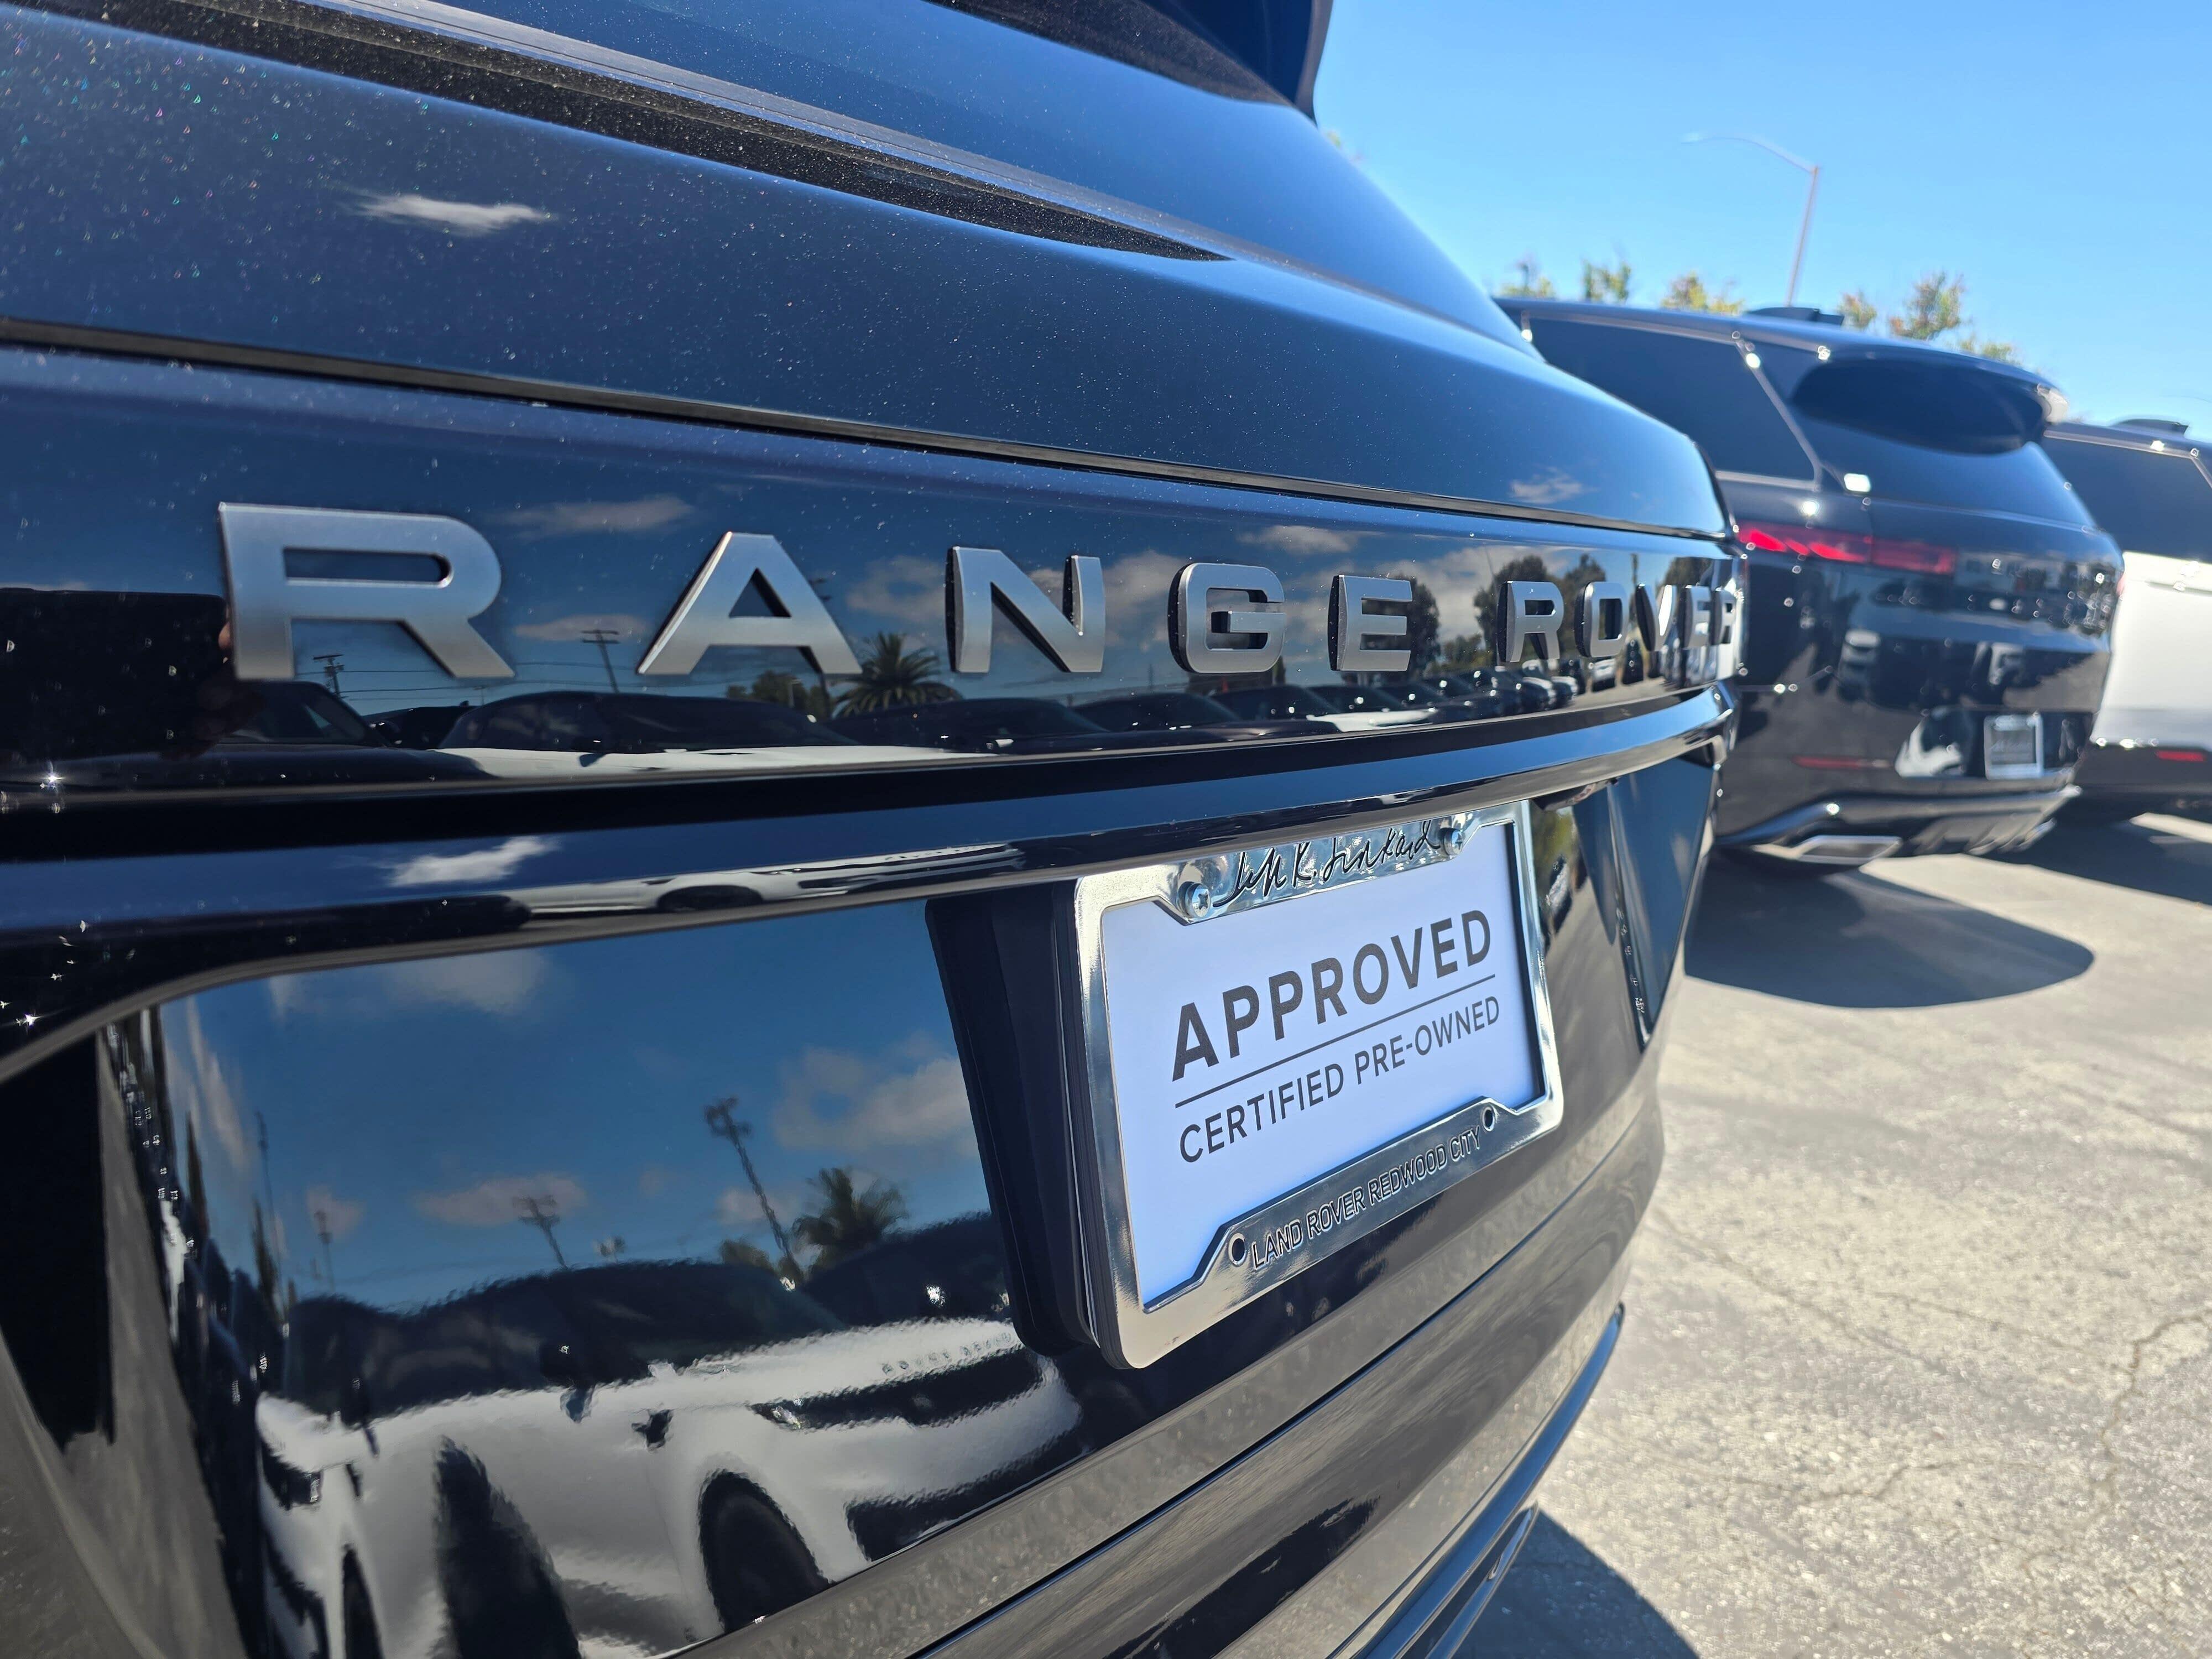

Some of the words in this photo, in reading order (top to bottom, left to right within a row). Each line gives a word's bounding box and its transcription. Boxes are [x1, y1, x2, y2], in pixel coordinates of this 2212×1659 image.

[219, 501, 1413, 680] RANGE
[1496, 580, 1739, 663] ROVER
[1171, 910, 1491, 1082] APPROVED
[1179, 1063, 1344, 1163] CERTIFIED
[1354, 995, 1500, 1085] PRE-OWNED
[1251, 1220, 1303, 1270] LAND
[1307, 1186, 1366, 1240] ROVER
[1368, 1144, 1447, 1206] REDWOOD
[1449, 1124, 1481, 1162] CITY
